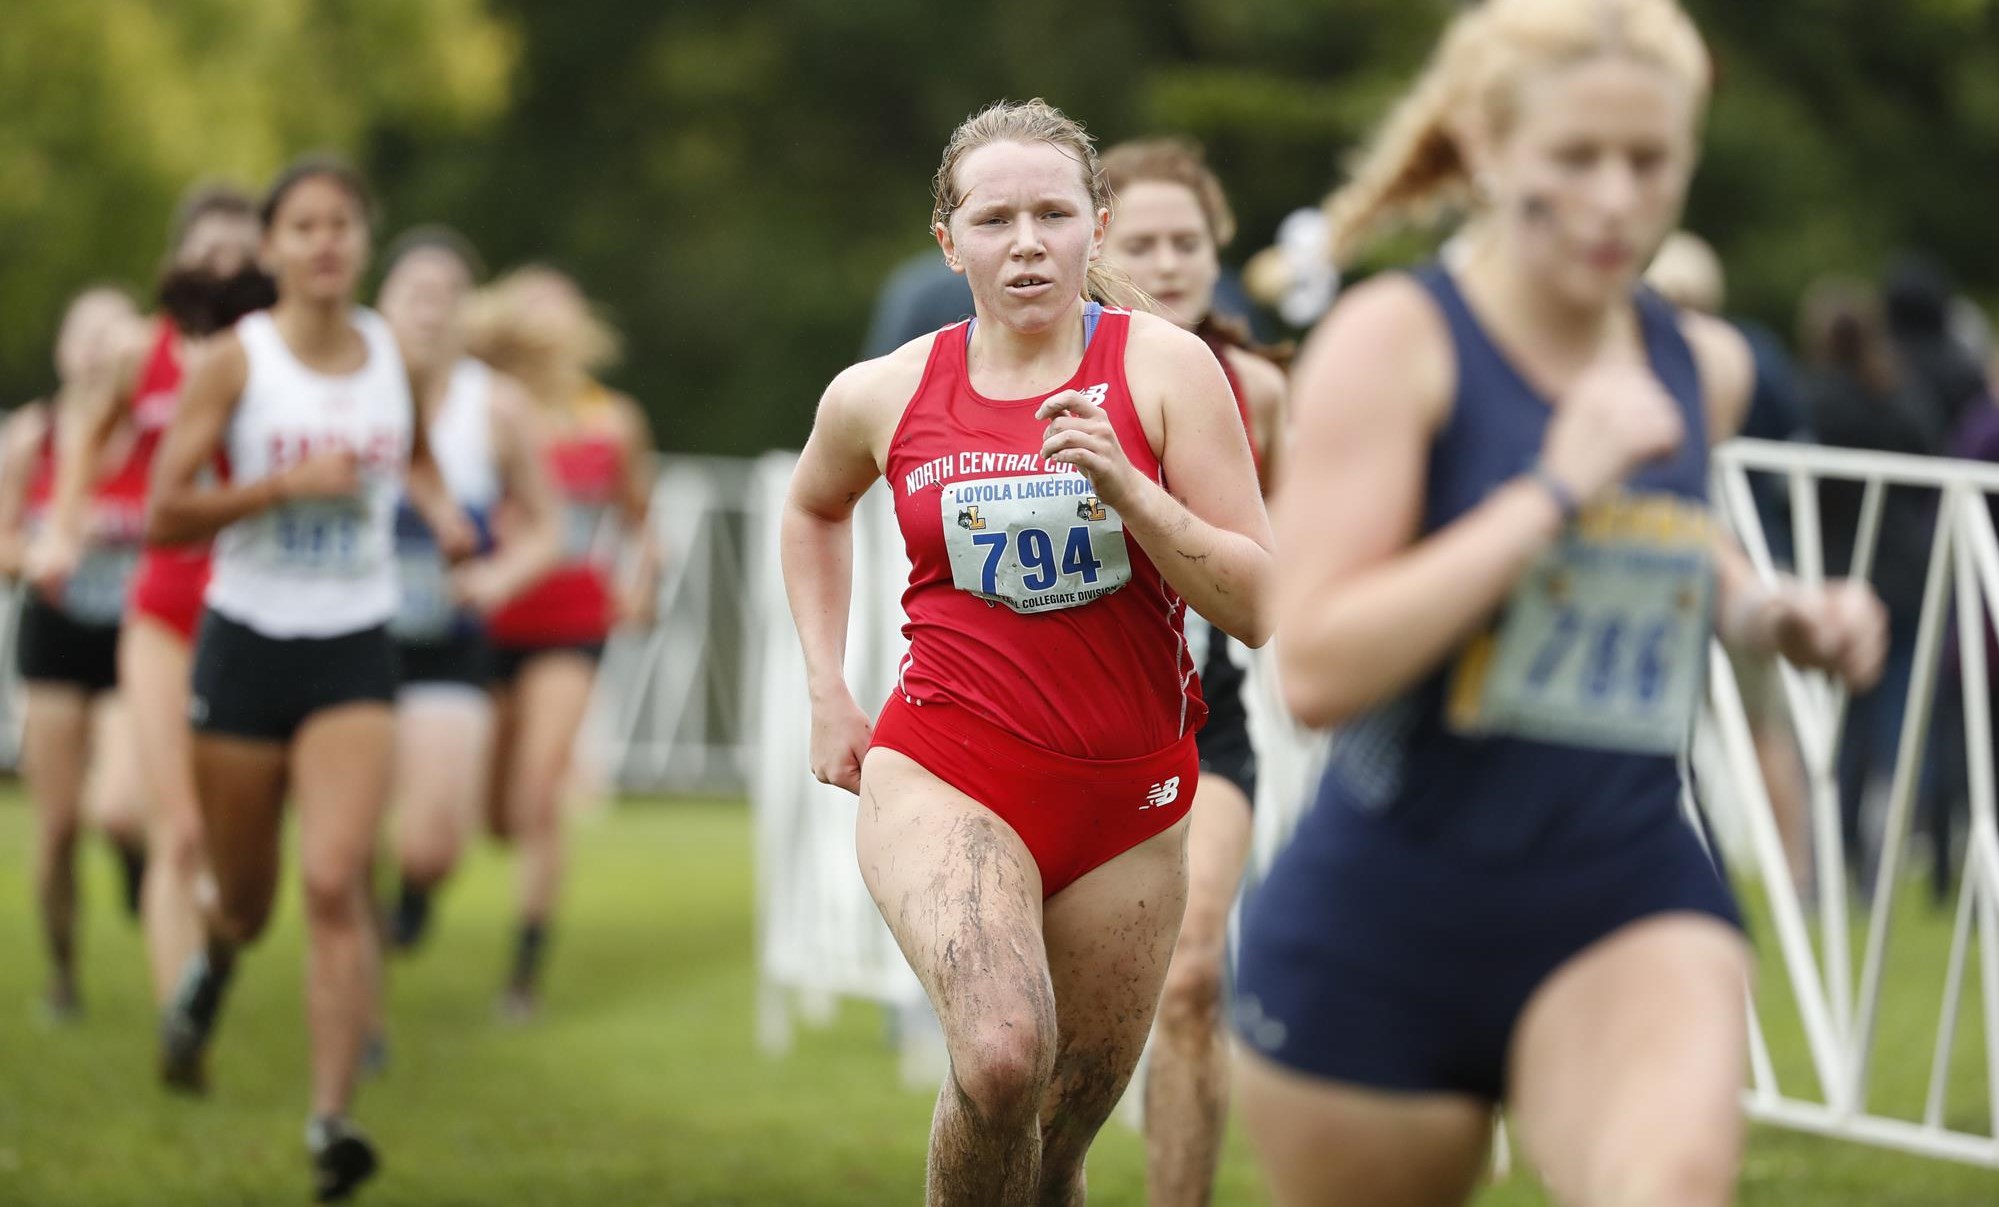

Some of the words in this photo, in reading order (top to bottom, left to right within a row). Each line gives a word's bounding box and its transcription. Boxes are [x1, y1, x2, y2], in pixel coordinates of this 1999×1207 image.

[905, 454, 954, 496] NORTH
[959, 451, 1039, 475] CENTRAL
[955, 484, 1012, 504] LOYOLA
[1017, 478, 1094, 499] LAKEFRON
[972, 526, 1102, 596] 794
[1022, 592, 1076, 609] COLLEGIATE
